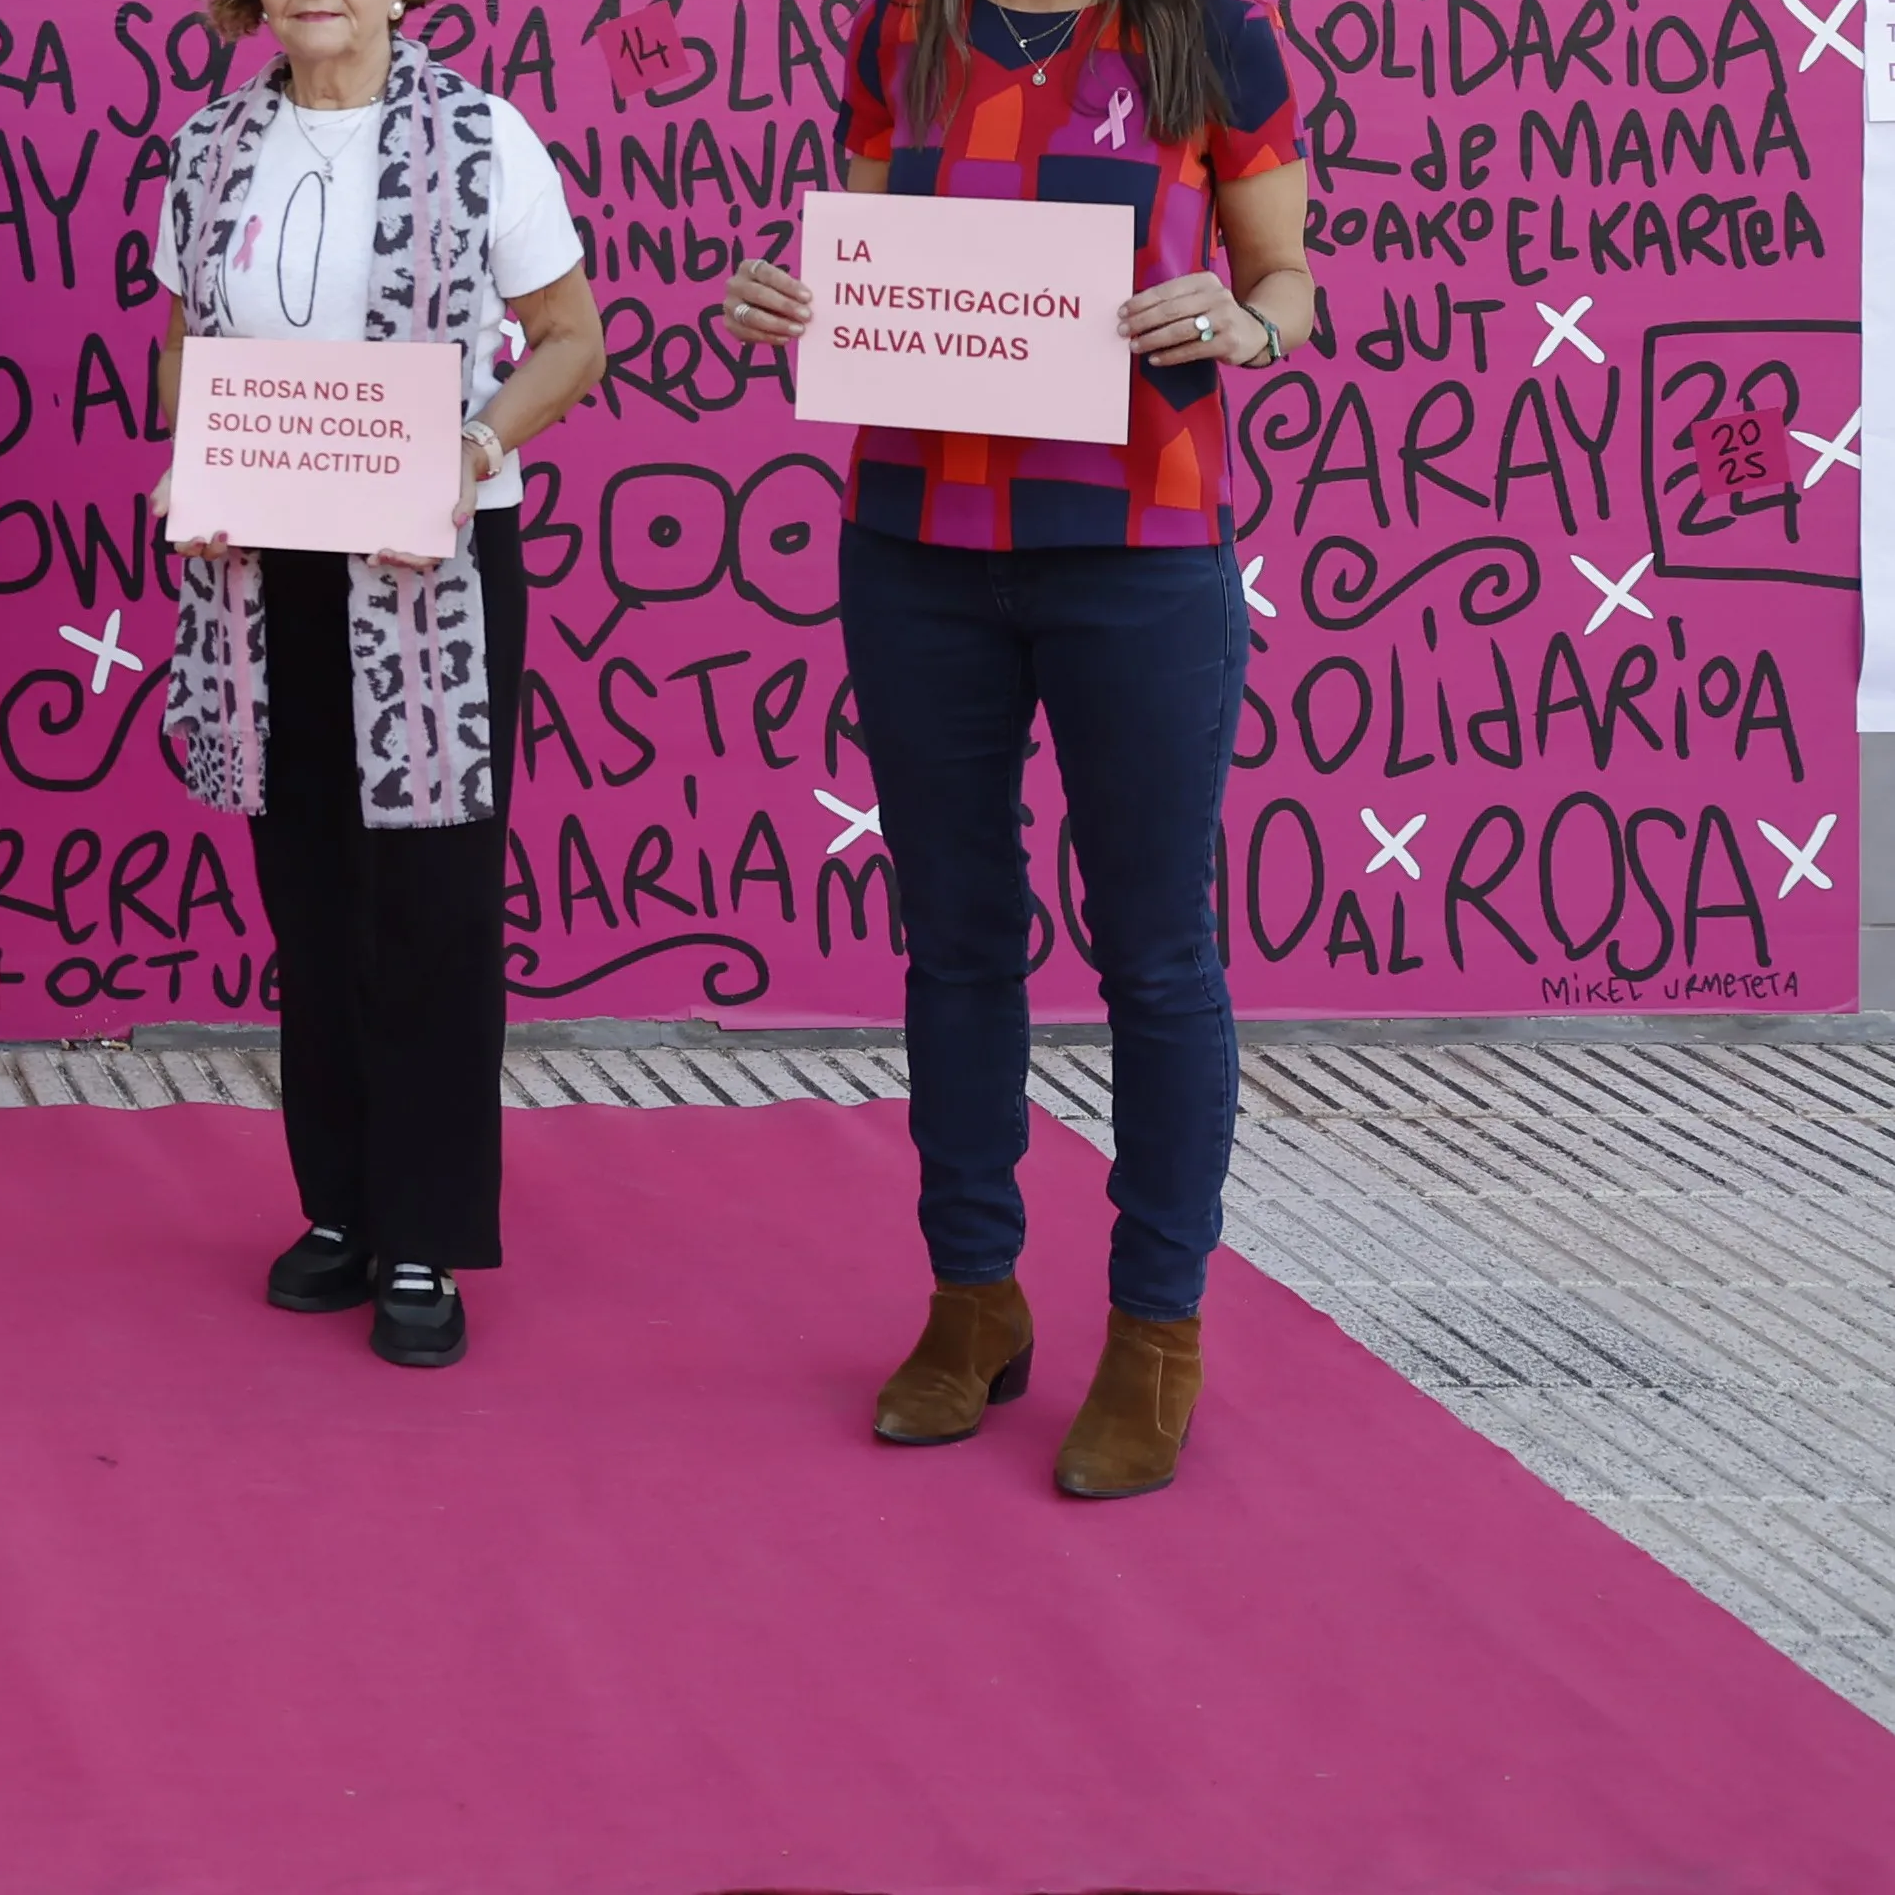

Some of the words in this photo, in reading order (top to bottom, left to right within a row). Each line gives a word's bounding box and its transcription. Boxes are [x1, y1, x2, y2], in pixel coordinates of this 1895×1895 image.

[618, 29, 673, 76] 14
[1519, 89, 1811, 189] MAMA
[837, 239, 871, 262] LA
[835, 283, 1080, 319] INVESTIGACIÓN
[833, 326, 926, 354] SALVA
[934, 333, 1028, 360] VIDAS
[211, 378, 236, 396] EL
[244, 379, 306, 399] ROSA
[314, 381, 348, 400] NO
[357, 383, 384, 402] ES
[208, 413, 271, 433] SOLO
[279, 416, 312, 435] UN
[321, 417, 410, 442] COLOR,
[206, 447, 234, 466] ES
[241, 449, 291, 469] UNA
[298, 452, 400, 474] ACTITUD
[1445, 790, 1772, 983] ROSA
